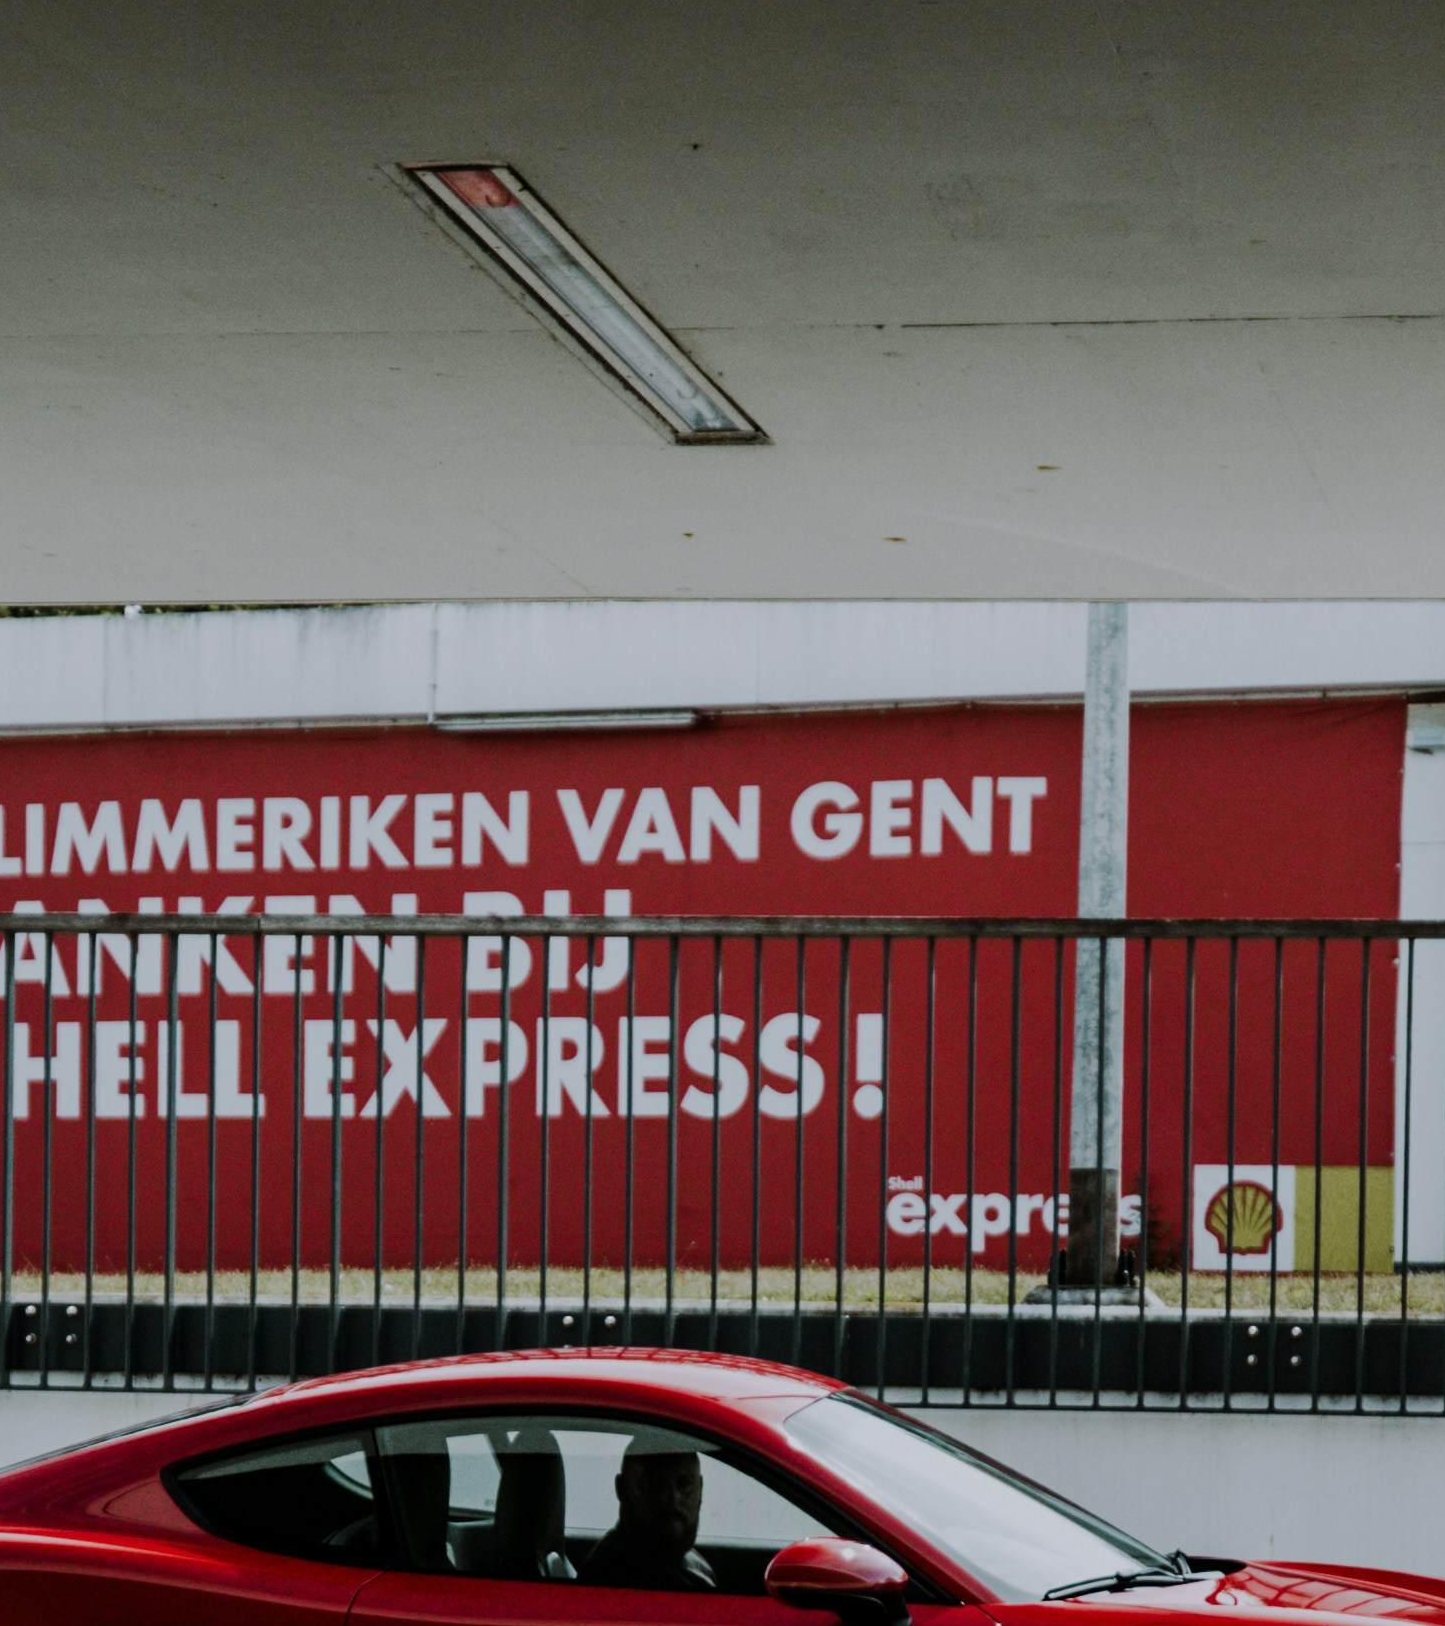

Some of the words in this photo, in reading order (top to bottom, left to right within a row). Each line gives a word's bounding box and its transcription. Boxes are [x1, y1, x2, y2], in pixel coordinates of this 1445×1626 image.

[557, 784, 759, 863] VAN
[790, 776, 1047, 860] GENT
[463, 888, 632, 993] BIJ
[302, 1012, 825, 1120] EXPRESS
[885, 1191, 1143, 1252] expres
[887, 1175, 924, 1191] Shell
